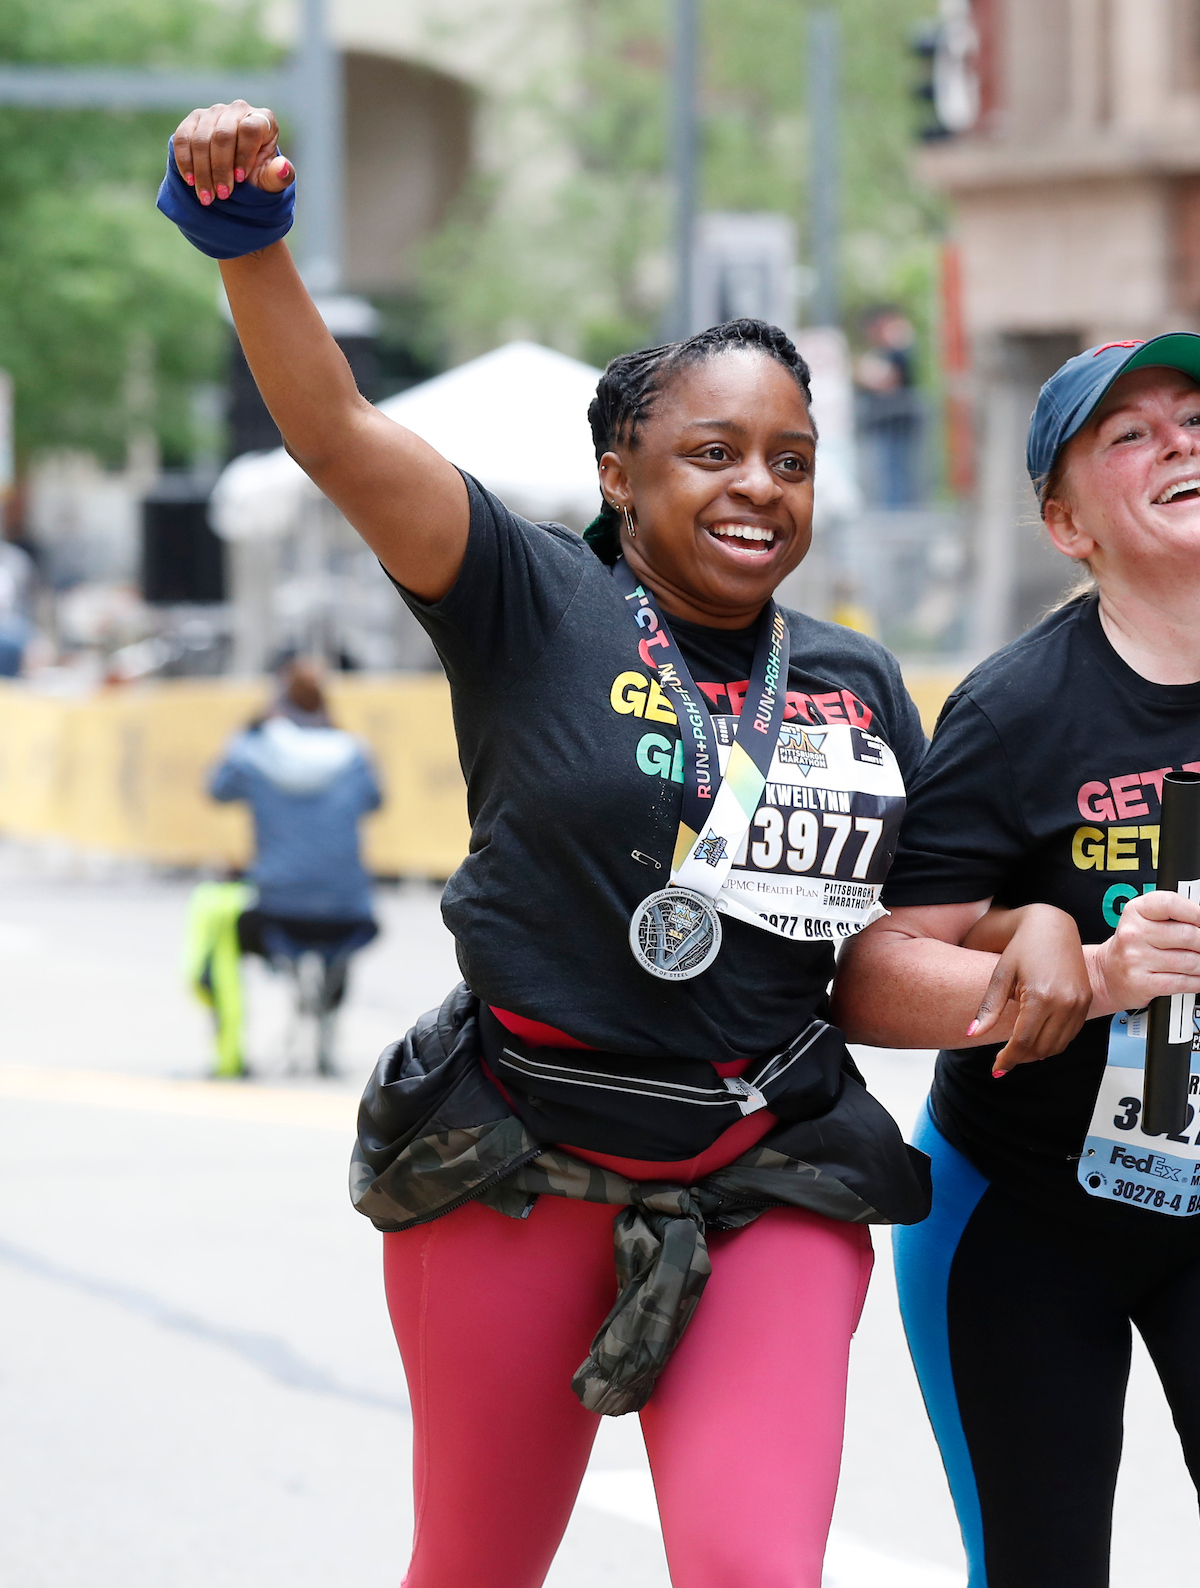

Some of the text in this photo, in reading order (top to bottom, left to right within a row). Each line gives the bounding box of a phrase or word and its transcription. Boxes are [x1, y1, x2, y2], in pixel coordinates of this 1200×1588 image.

[753, 612, 785, 735] RUN+PGH=FUN
[610, 671, 677, 725] GE
[780, 748, 825, 761] PITTSBURGH
[780, 755, 828, 768] MARATHON
[765, 783, 850, 813] KWEILYNN
[1077, 767, 1173, 822] GET
[722, 879, 754, 892] UPMC
[796, 885, 819, 898] PLAN
[805, 918, 833, 938] BAG
[1109, 1145, 1182, 1182] FedEx
[1112, 1179, 1182, 1211] 30278-4
